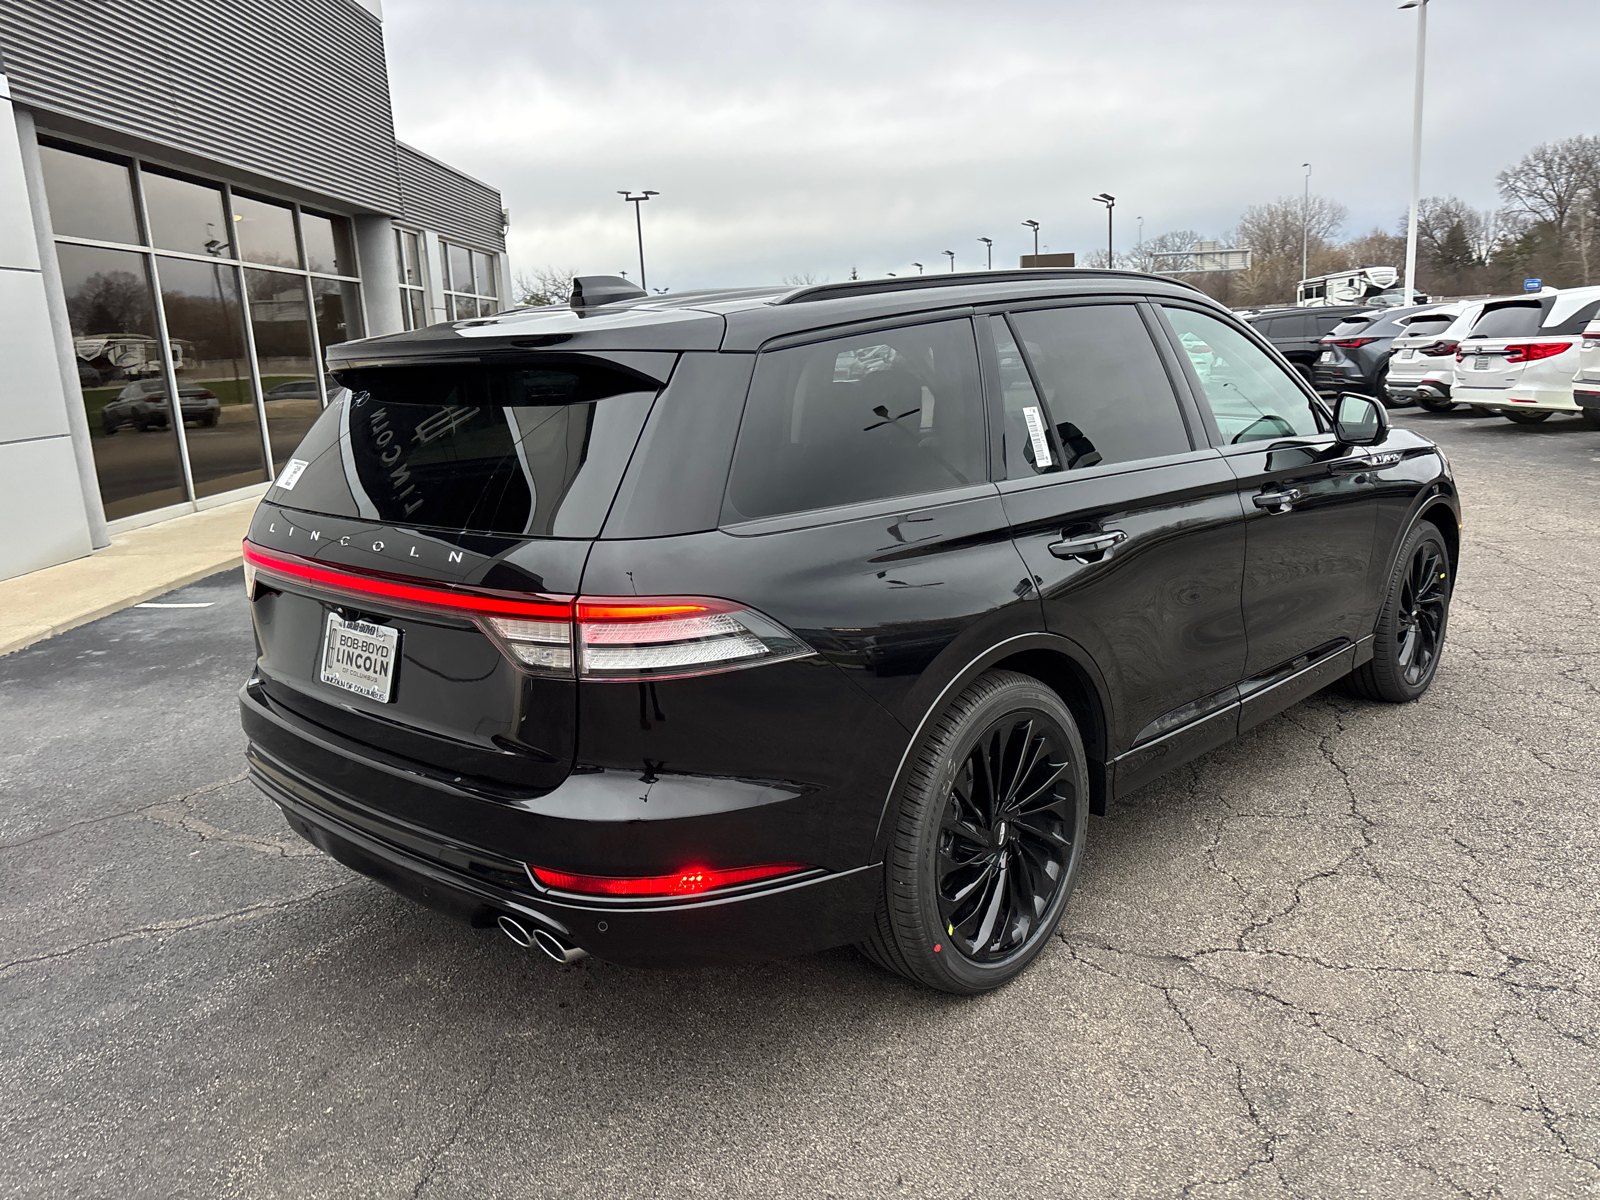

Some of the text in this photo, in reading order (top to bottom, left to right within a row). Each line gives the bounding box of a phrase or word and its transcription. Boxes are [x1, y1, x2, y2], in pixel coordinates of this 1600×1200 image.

[269, 523, 463, 563] LINCOLN
[340, 635, 389, 658] BOB-BOYD
[336, 647, 389, 677] LINCOLN
[346, 681, 354, 690] OF
[350, 669, 378, 683] COLUMBUS
